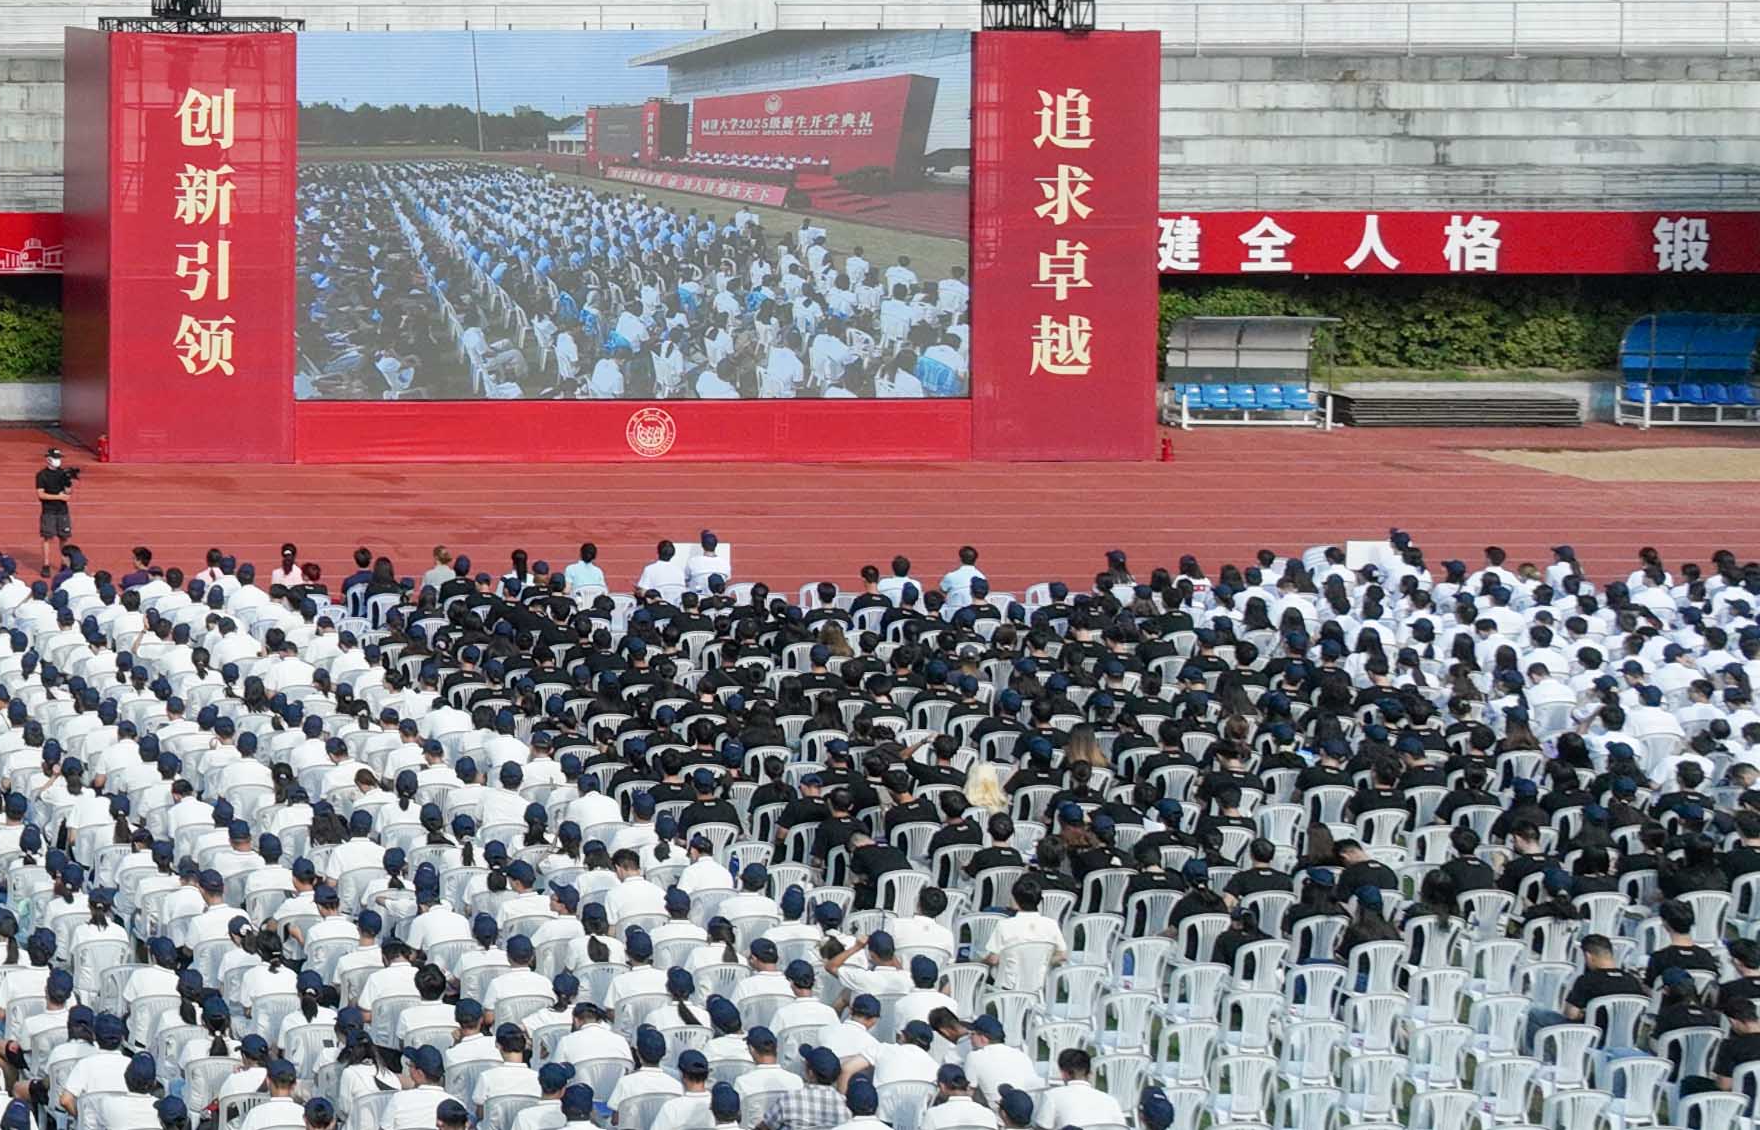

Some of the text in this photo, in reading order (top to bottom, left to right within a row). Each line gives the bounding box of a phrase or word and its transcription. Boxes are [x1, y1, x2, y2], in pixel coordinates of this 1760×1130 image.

[173, 87, 237, 376] 创新引领
[1029, 88, 1094, 375] 追求卓越
[1654, 217, 1709, 272] 锻
